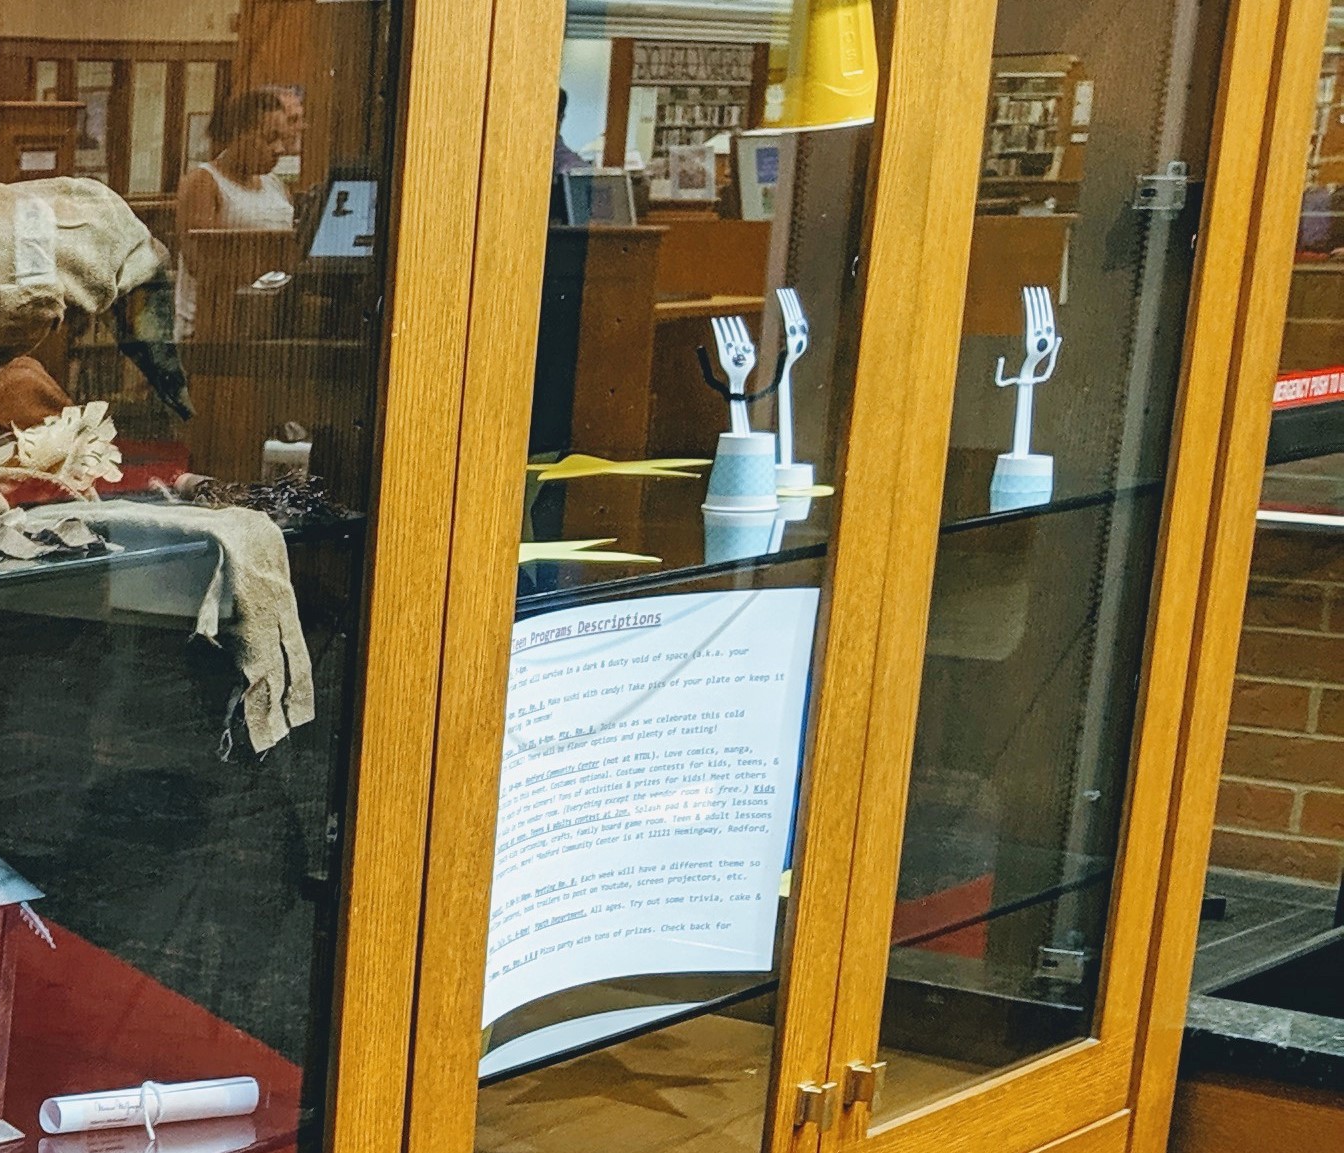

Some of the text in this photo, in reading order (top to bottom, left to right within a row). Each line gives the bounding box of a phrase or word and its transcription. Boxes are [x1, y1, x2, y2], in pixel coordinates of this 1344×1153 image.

[529, 622, 572, 646] Programs
[577, 609, 661, 634] Descriptions
[582, 662, 597, 671] dark
[607, 657, 627, 668] dusty
[631, 655, 648, 663] void
[665, 654, 688, 662] space
[600, 685, 623, 696] candy!
[628, 682, 644, 690] Take
[648, 680, 666, 690] pics
[705, 675, 730, 684] plate
[748, 674, 770, 682] keep
[655, 713, 696, 723] celebrate
[701, 711, 720, 719] this
[636, 728, 662, 739] plenty
[680, 724, 717, 735] tasting!
[664, 749, 682, 757] Love
[686, 746, 718, 756] comics,
[615, 766, 645, 776] Costume
[648, 762, 684, 771] contests
[689, 760, 703, 768] for
[707, 759, 730, 767] kids,
[736, 758, 767, 766] teens,
[584, 781, 622, 795] activities
[633, 777, 660, 788] prizes
[718, 785, 749, 794] free.)
[664, 802, 679, 811] pad
[692, 799, 727, 808] archery
[672, 813, 691, 821] Teen
[727, 824, 770, 832] Redford,
[669, 861, 713, 869] different
[667, 873, 721, 884] projectors,
[590, 905, 601, 914] All
[606, 903, 624, 911] ages.
[629, 899, 642, 908] Try
[646, 897, 660, 905] out
[688, 894, 723, 903] trivia,
[625, 926, 655, 936] prizes.
[660, 923, 685, 931] Check
